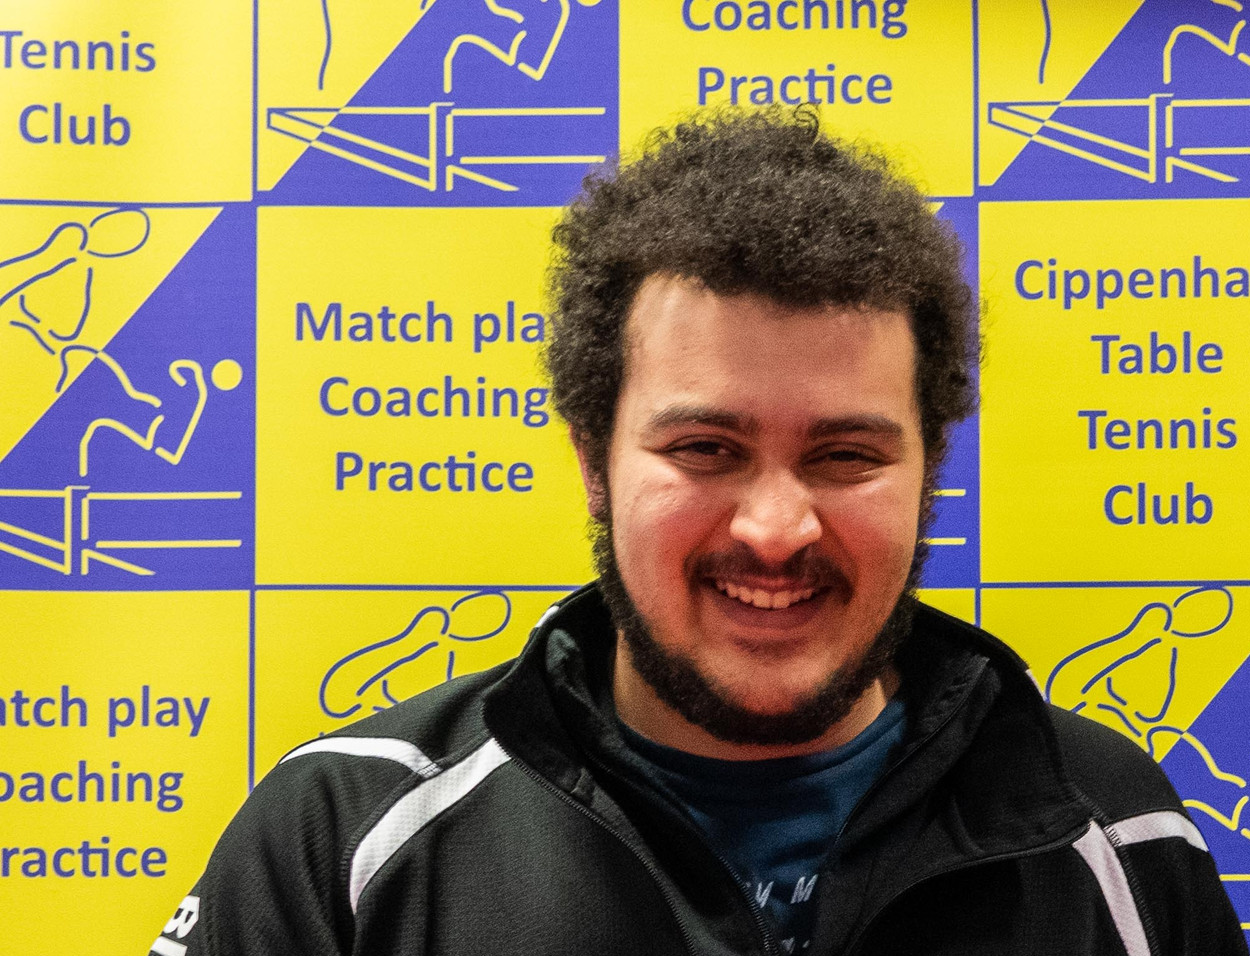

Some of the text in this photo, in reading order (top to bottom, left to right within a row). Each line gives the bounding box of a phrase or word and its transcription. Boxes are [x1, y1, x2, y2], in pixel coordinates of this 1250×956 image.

[683, 0, 908, 39] Coaching
[0, 30, 156, 72] Tennis
[698, 64, 892, 105] Practice
[19, 103, 131, 146] Club
[295, 301, 546, 353] Match pla
[1091, 332, 1223, 375] Table
[319, 375, 549, 428] Coaching
[1077, 408, 1237, 450] Tennis
[336, 451, 534, 492] Practice
[1104, 483, 1213, 525] Club
[0, 685, 210, 737] tch play
[0, 760, 184, 812] oaching
[0, 836, 167, 877] ractice
